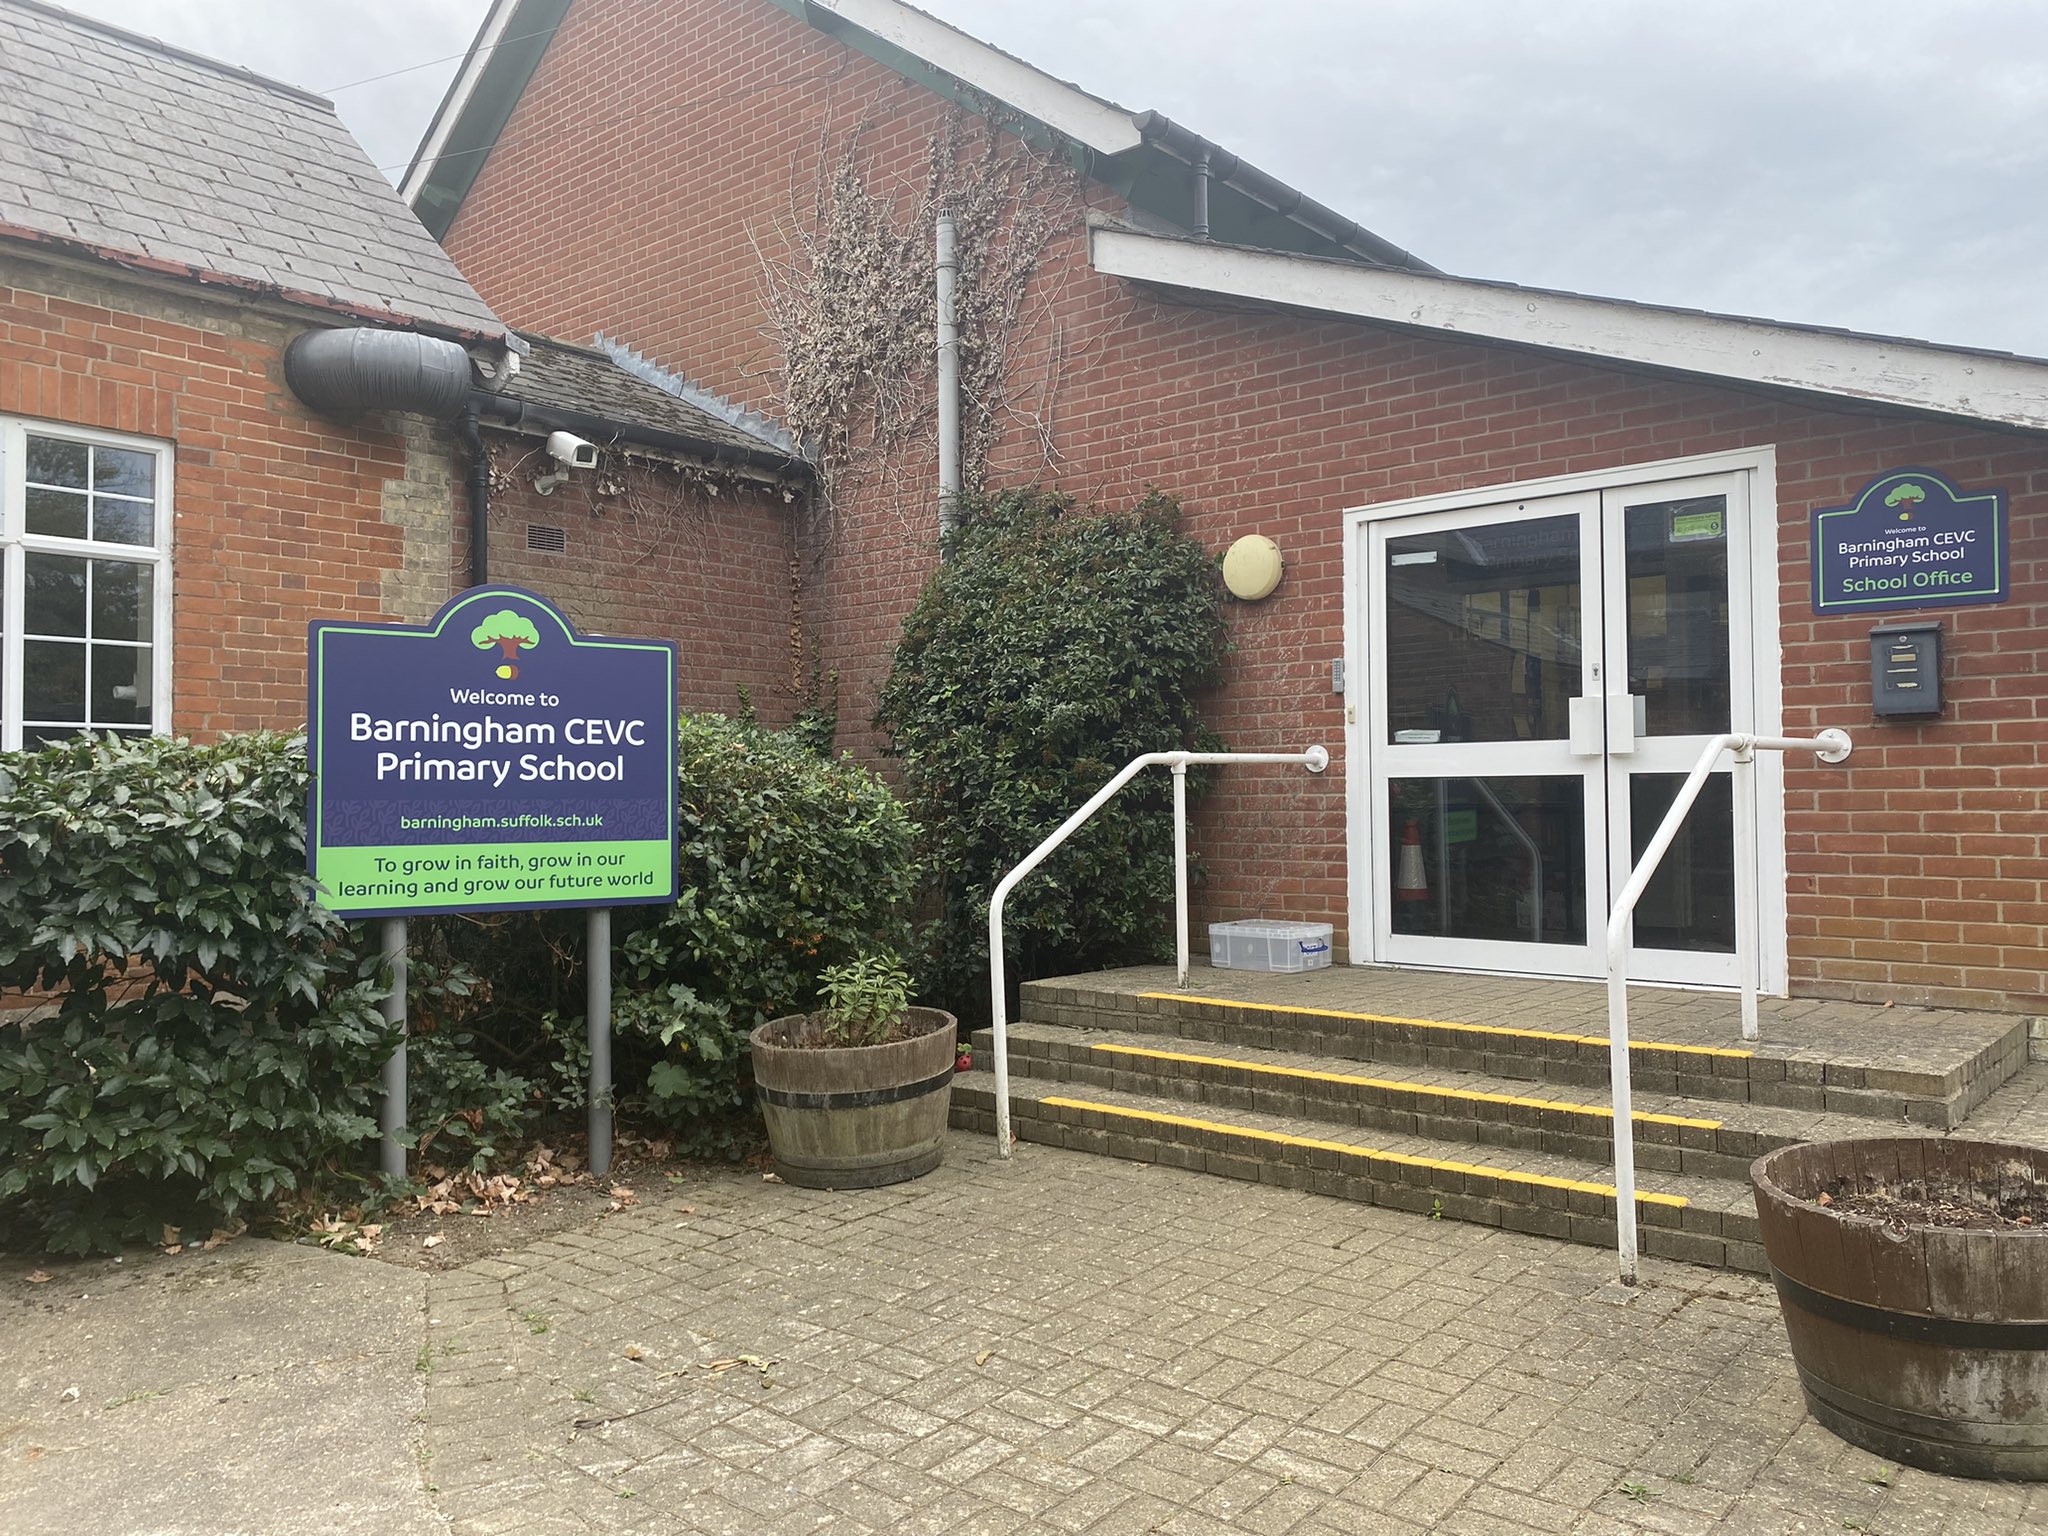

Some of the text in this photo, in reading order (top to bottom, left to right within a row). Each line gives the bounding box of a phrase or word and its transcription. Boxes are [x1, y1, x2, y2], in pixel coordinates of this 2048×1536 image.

[1838, 530, 1976, 554] Barningham CEVC
[1884, 526, 1917, 535] Welcome
[1849, 547, 1965, 568] Primary School
[1842, 570, 1973, 593] School Office
[450, 688, 560, 707] Welcome to
[350, 712, 645, 750] Barningham CEVC
[377, 751, 624, 788] Primary School
[400, 814, 603, 831] barningham.suffolk.sch.uk
[374, 852, 625, 876] To grow in faith, grow in our
[338, 871, 653, 897] learning and grow our future world
